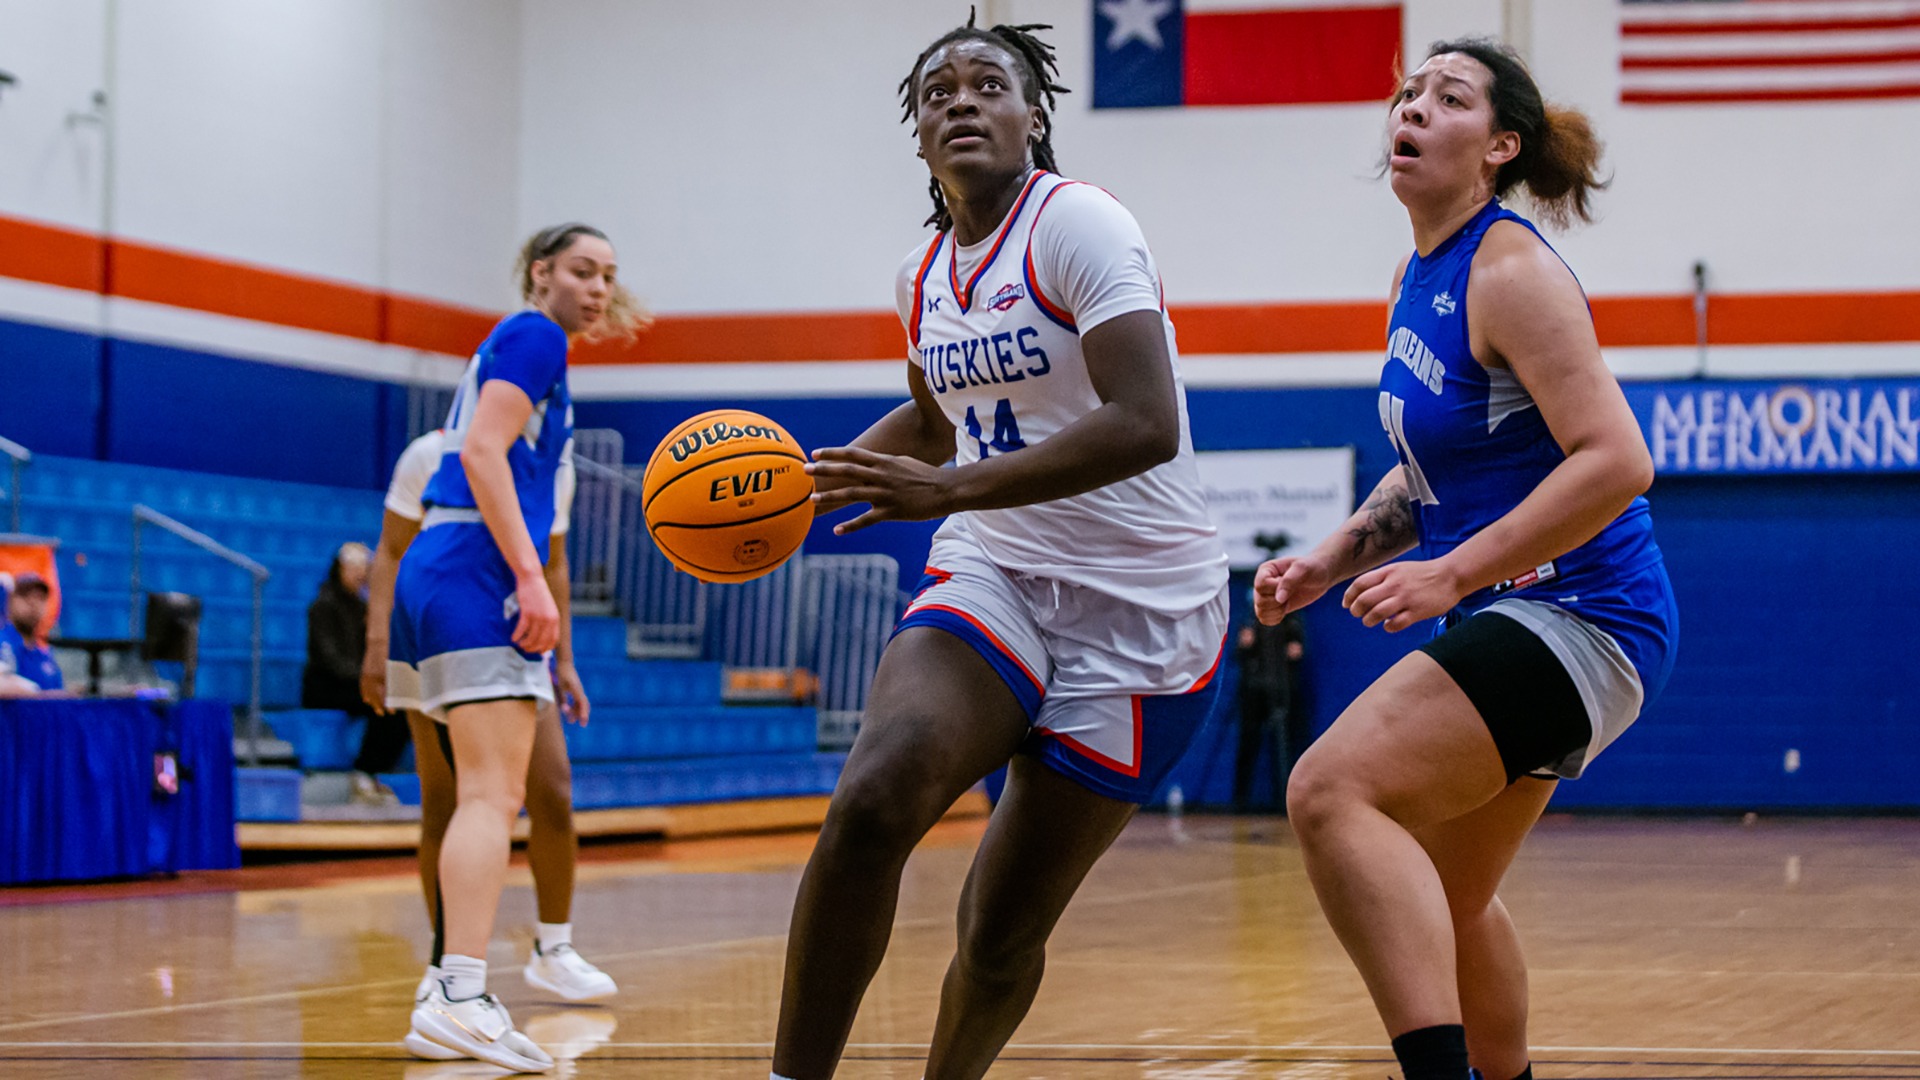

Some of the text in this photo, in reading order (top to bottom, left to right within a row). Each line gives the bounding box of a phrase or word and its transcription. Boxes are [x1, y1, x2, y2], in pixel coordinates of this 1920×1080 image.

[965, 398, 1028, 459] 14
[1653, 386, 1920, 436] MEMORIAL
[669, 423, 783, 461] Wilson
[1653, 422, 1918, 470] HERMANN
[709, 465, 790, 502] EVO NXT
